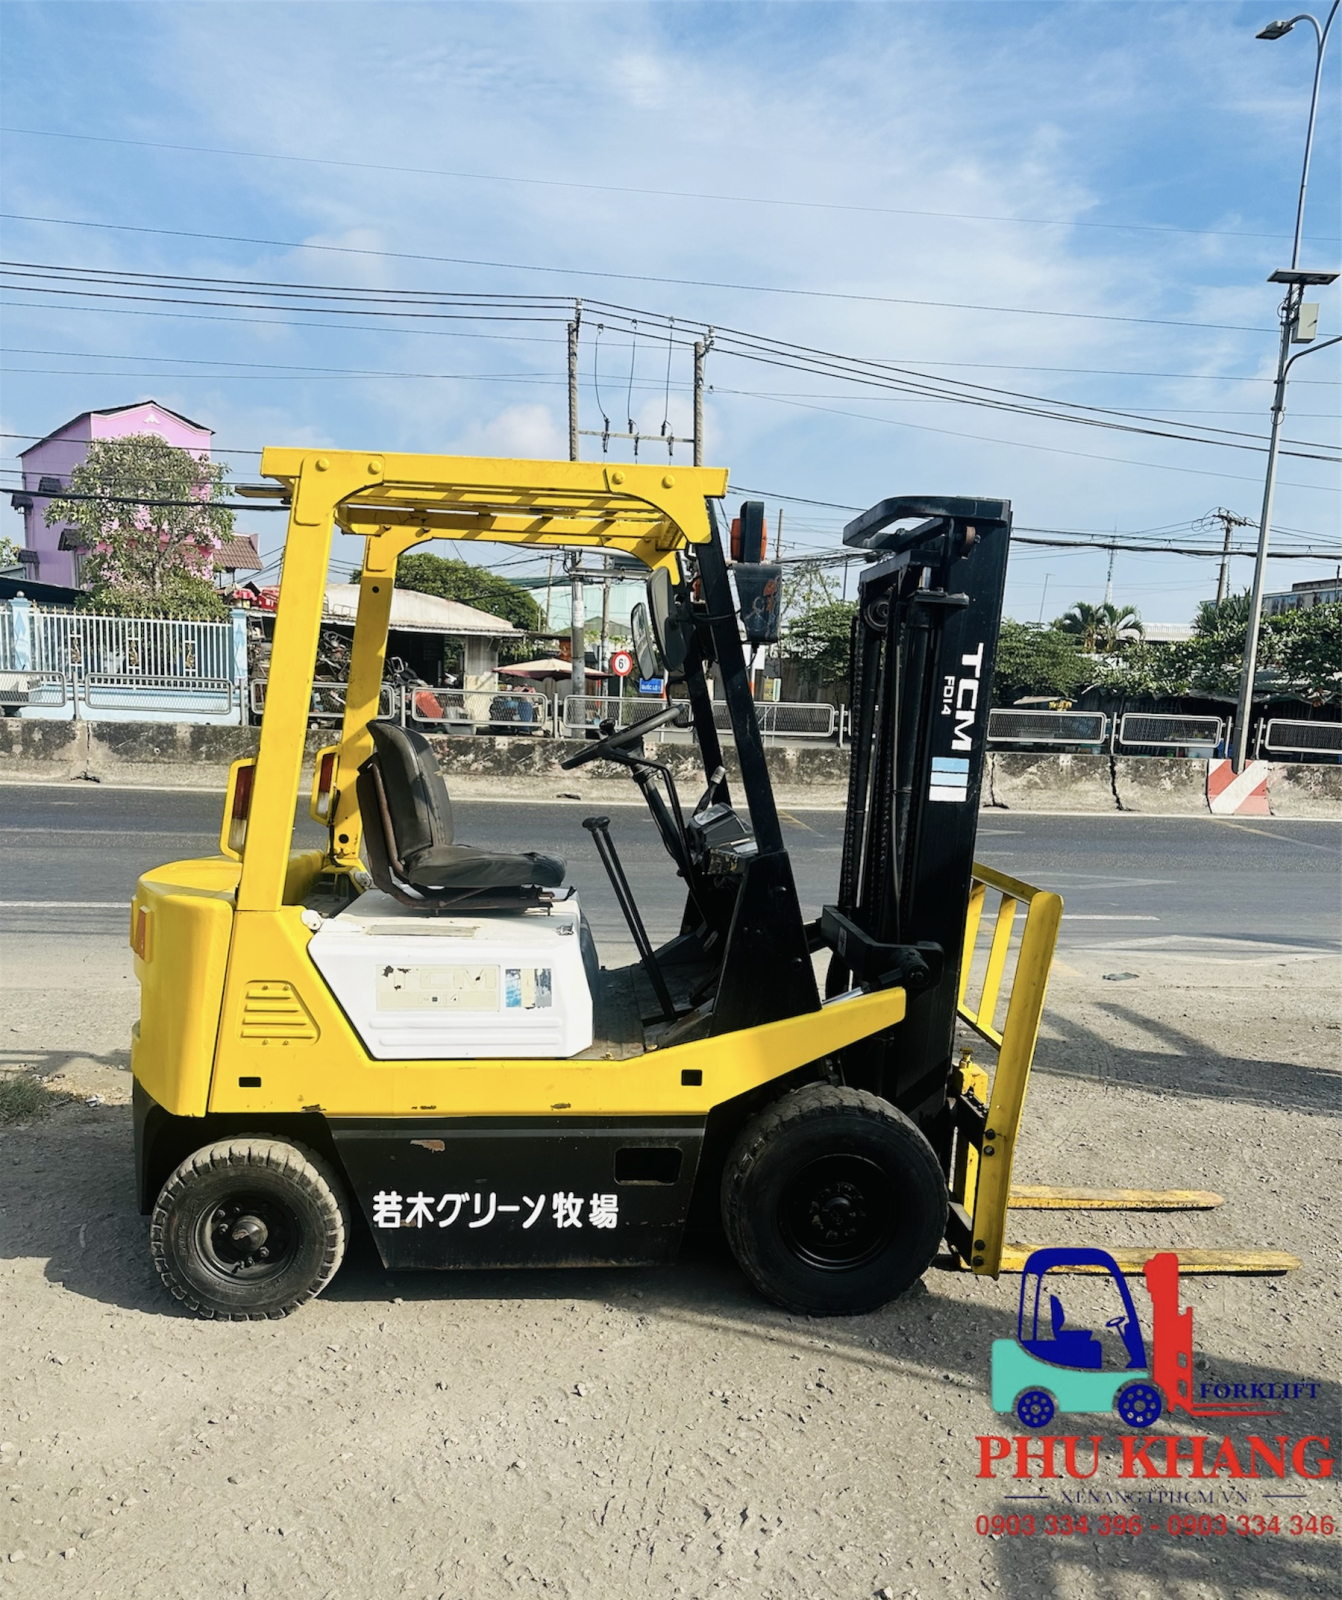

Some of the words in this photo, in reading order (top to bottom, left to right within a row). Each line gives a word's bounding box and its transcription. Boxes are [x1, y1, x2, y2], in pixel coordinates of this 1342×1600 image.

[941, 675, 955, 714] FD14
[951, 642, 984, 751] TCM
[373, 1190, 619, 1229] 若木グリーン牧場
